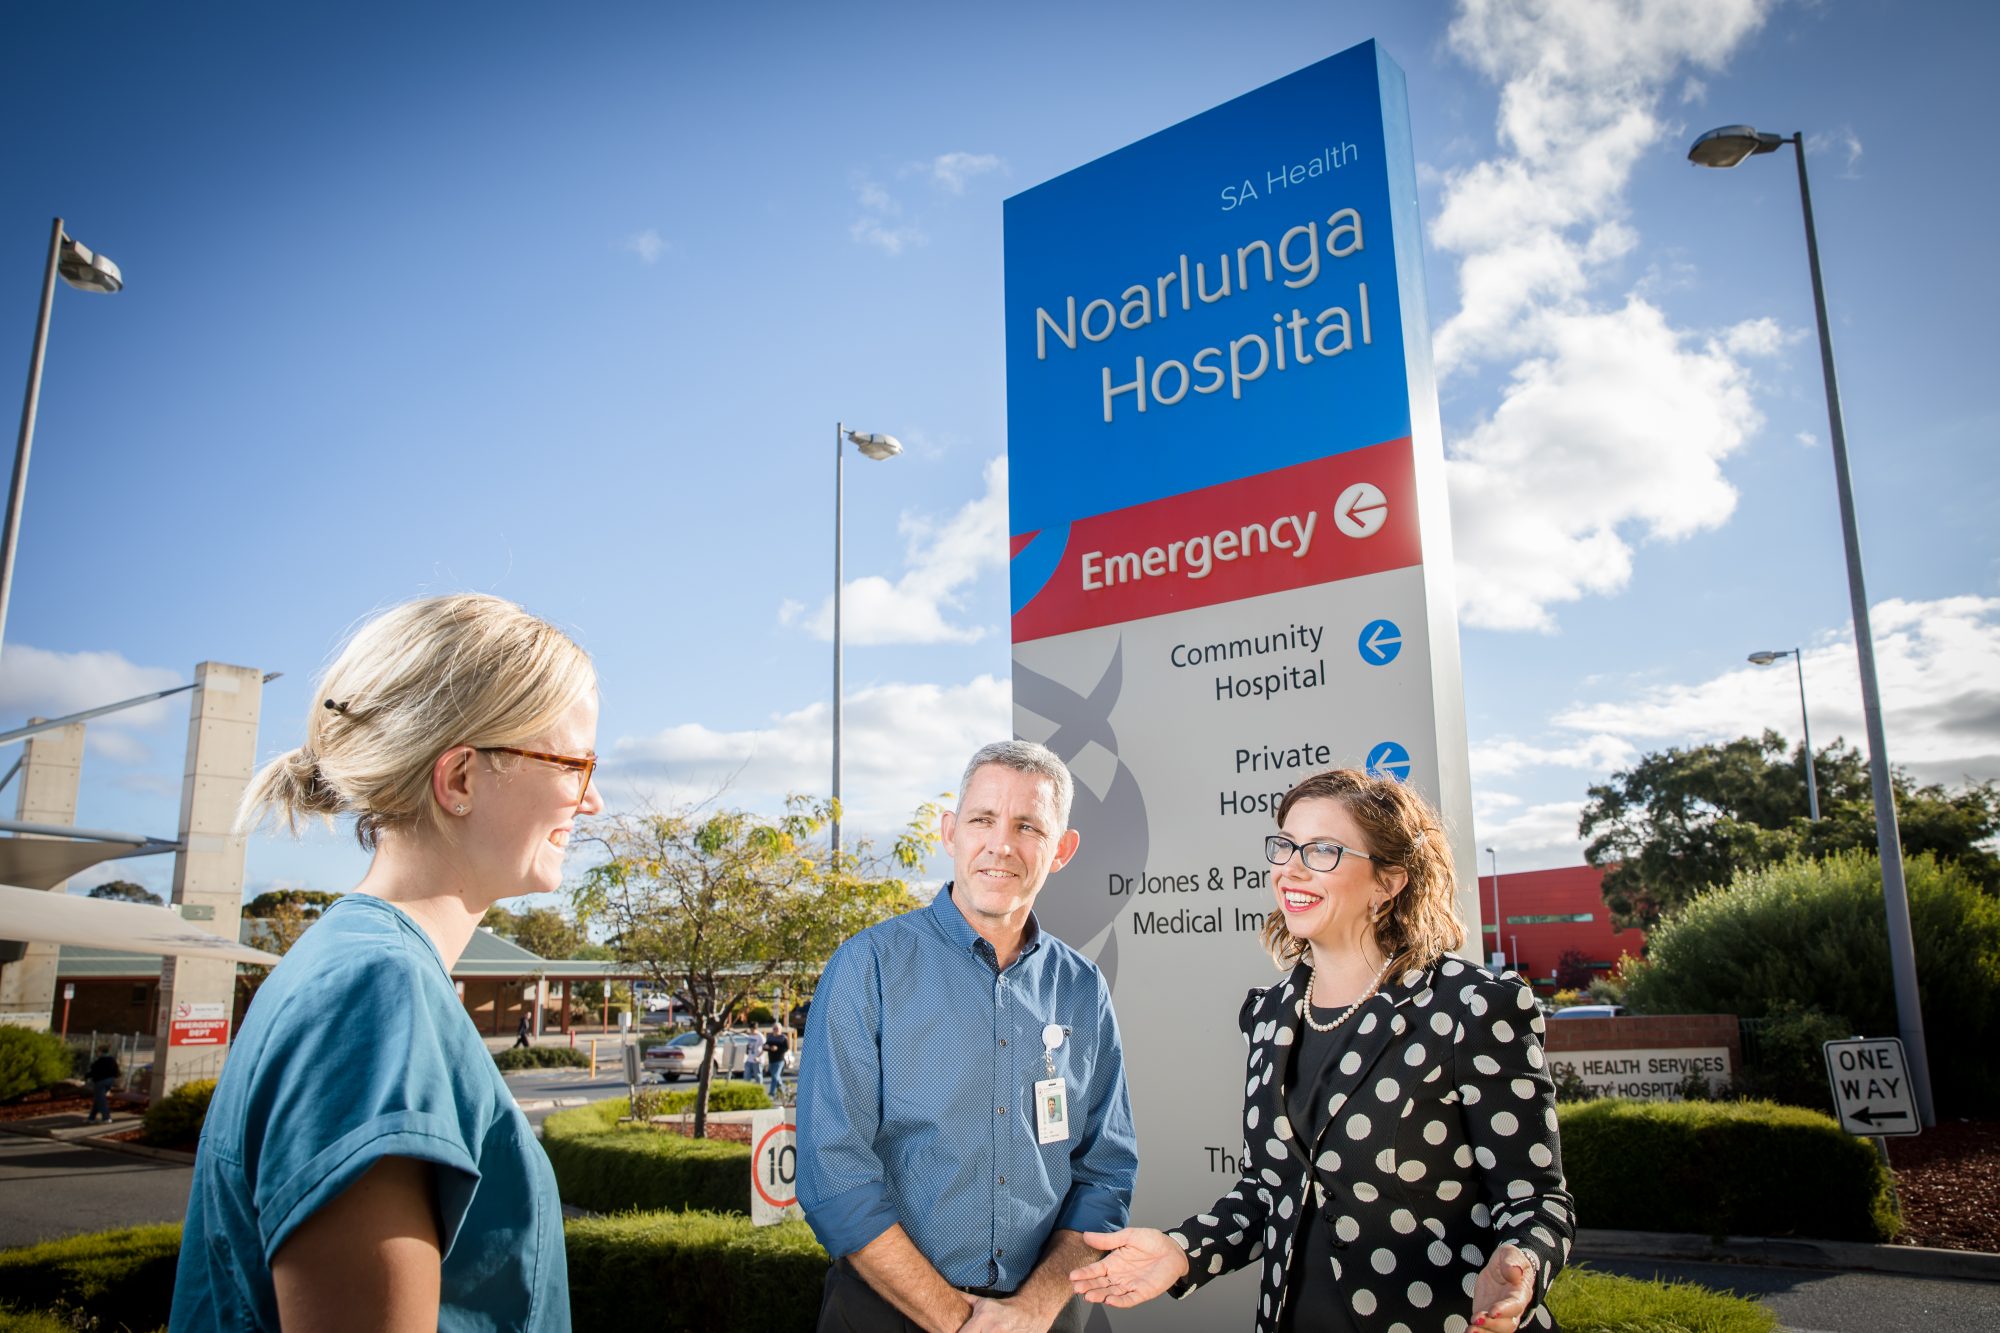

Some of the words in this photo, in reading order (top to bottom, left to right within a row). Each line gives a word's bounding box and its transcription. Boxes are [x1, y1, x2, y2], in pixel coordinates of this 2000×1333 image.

[1220, 178, 1259, 211] SA
[1267, 141, 1358, 194] Health
[1036, 207, 1365, 360] Noarlunga
[1102, 282, 1372, 423] Hospital
[1081, 510, 1318, 592] Emergency
[1170, 623, 1324, 668] Community
[1215, 660, 1326, 701] Hospital
[1236, 743, 1331, 774] Private
[1220, 783, 1292, 818] Hosp
[1108, 873, 1133, 896] Dr
[1138, 871, 1200, 895] Jones
[1207, 867, 1225, 891] &
[1233, 865, 1271, 889] Par
[1133, 906, 1222, 935] Medical
[1235, 907, 1272, 932] Im
[1550, 1061, 1577, 1079] GA
[1583, 1059, 1640, 1075] HEALTH
[1648, 1057, 1725, 1074] SERVICES
[1839, 1048, 1894, 1071] ONE
[1618, 1082, 1683, 1098] HOSPITA
[1840, 1078, 1900, 1100] WAY
[768, 1145, 797, 1186] 10
